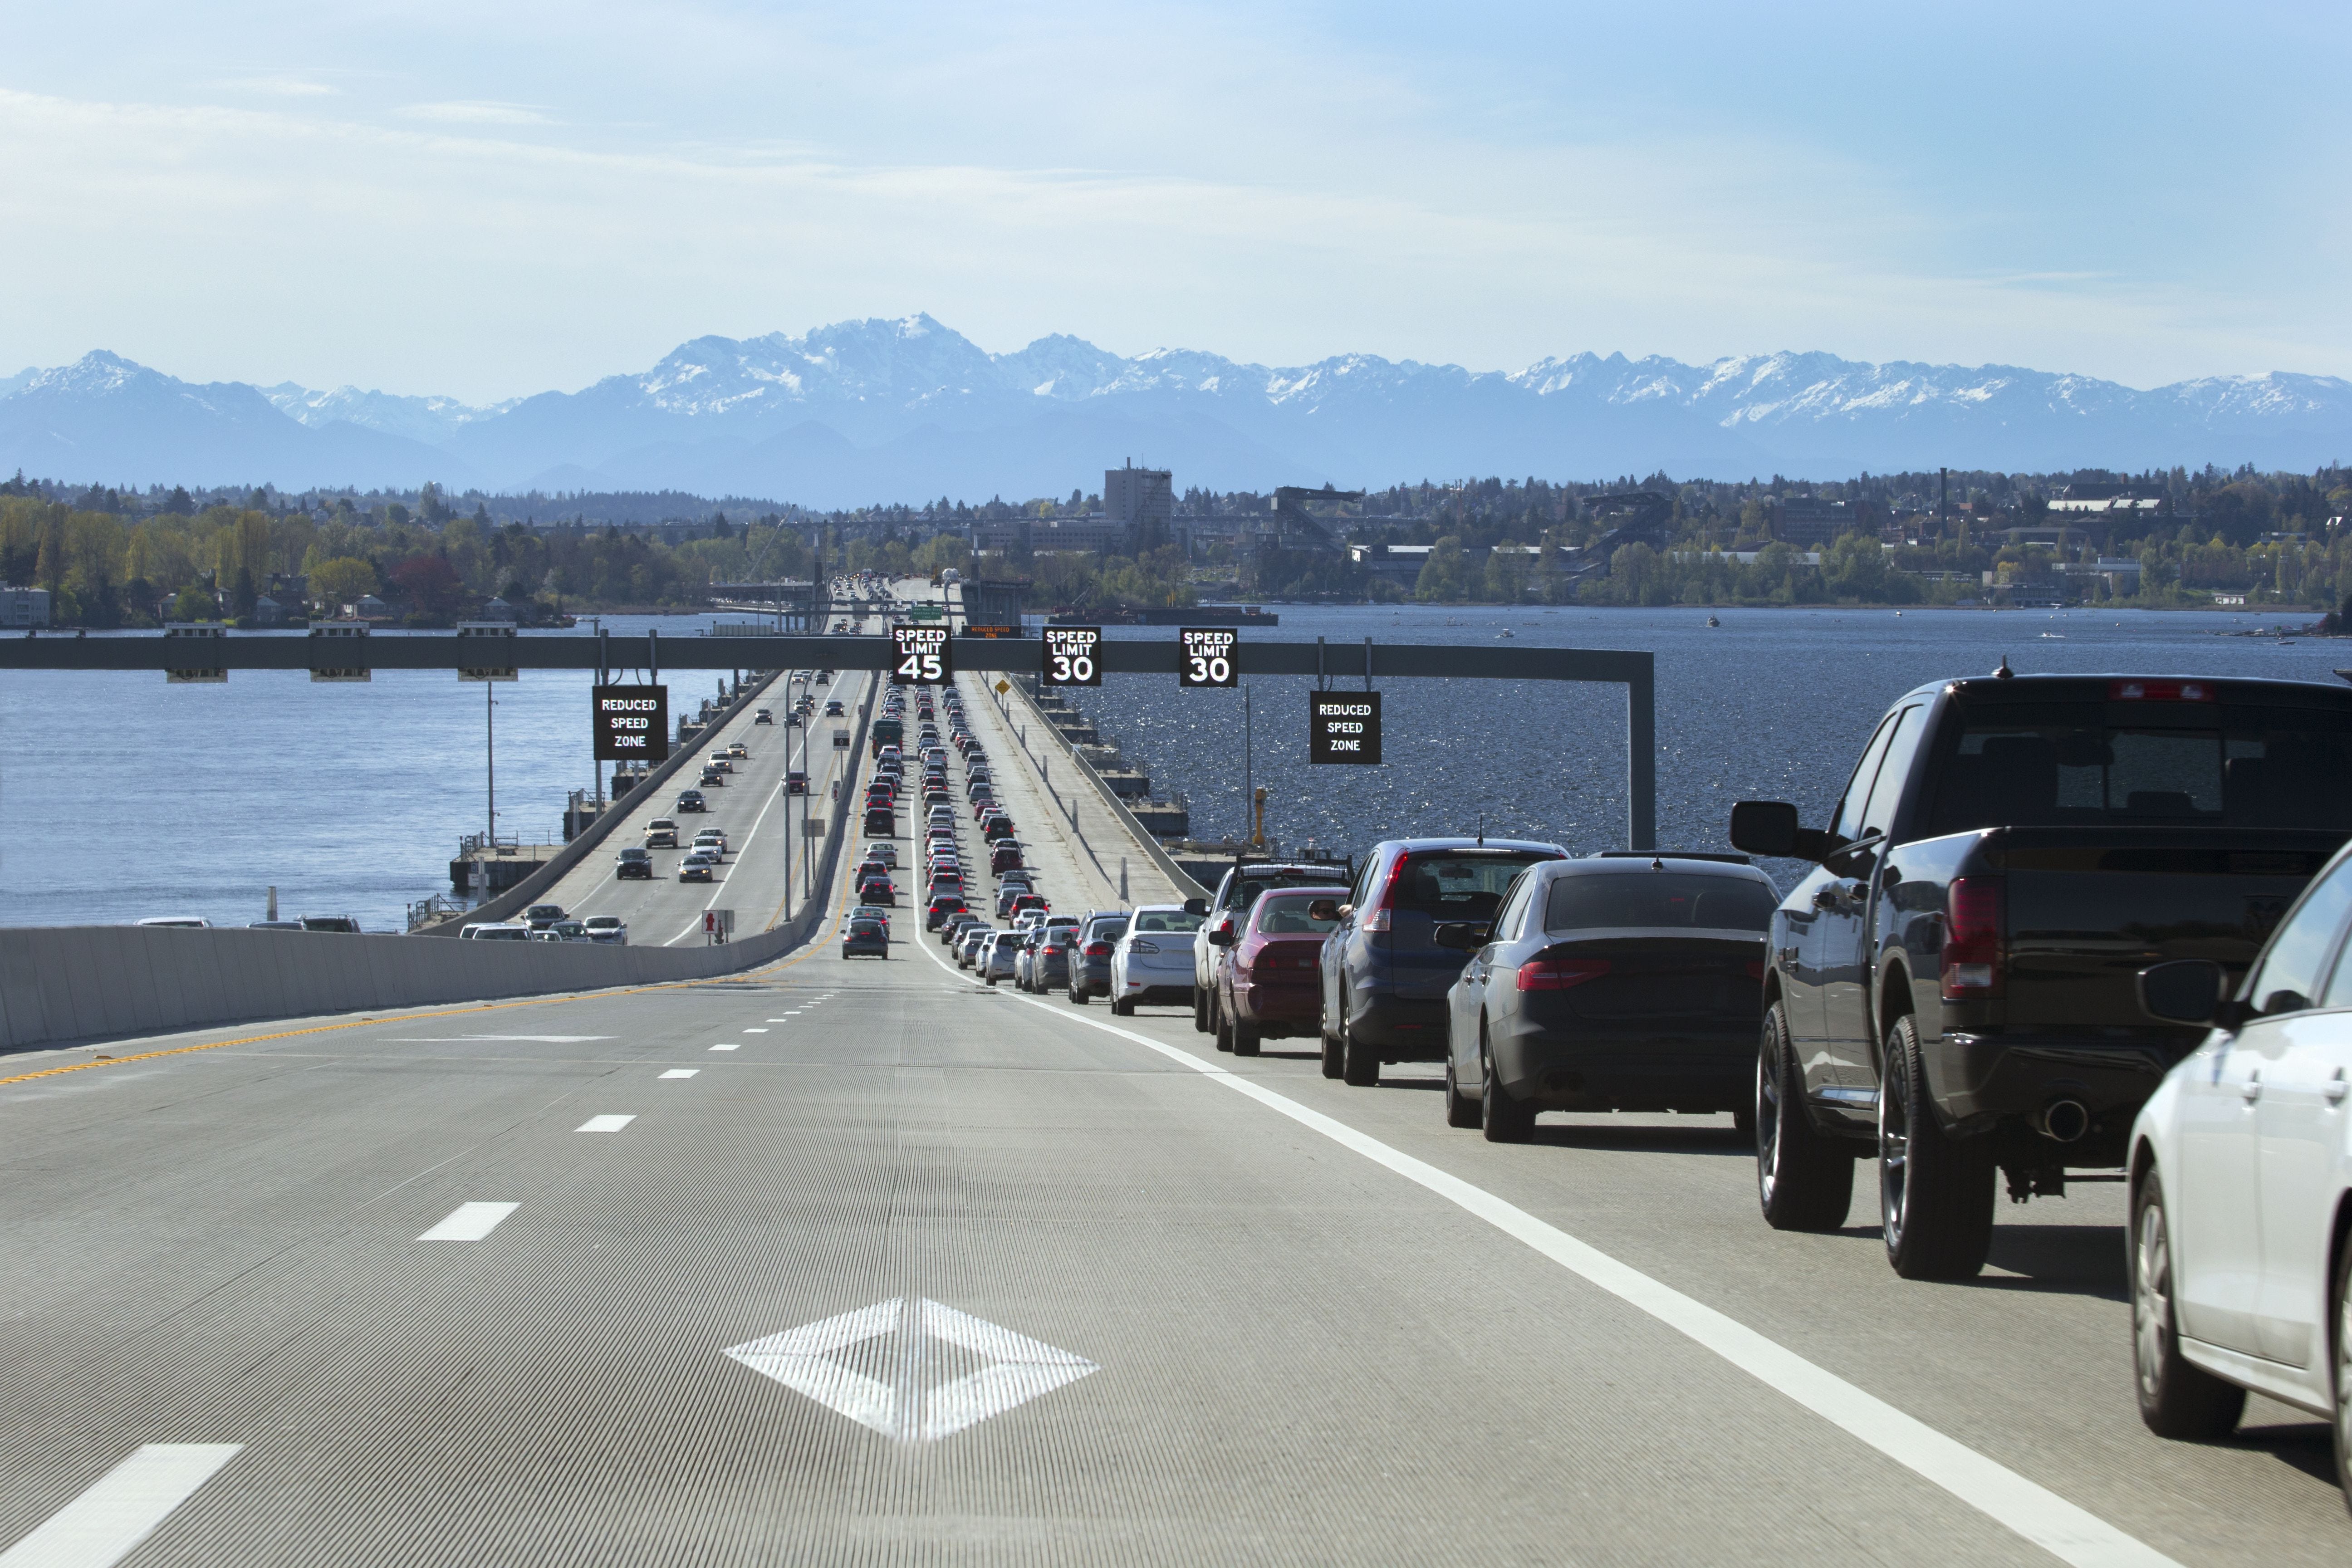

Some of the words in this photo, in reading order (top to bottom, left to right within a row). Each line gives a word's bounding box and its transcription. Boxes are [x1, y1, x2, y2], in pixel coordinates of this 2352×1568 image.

[896, 629, 946, 642] SPEED
[1046, 631, 1097, 643] SPEED
[1184, 632, 1233, 644] SPEED
[902, 642, 941, 654] LIMIT
[1053, 644, 1092, 656] LIMIT
[1190, 645, 1229, 657] LIMIT
[898, 655, 942, 680] 45
[1052, 656, 1093, 681] 30
[1189, 657, 1230, 682] 30
[602, 700, 657, 710] REDUCED
[1319, 705, 1371, 715] REDUCED
[611, 718, 648, 729] SPEED
[1327, 722, 1363, 733] SPEED
[615, 736, 646, 747] ZONE
[1330, 740, 1360, 751] ZONE
